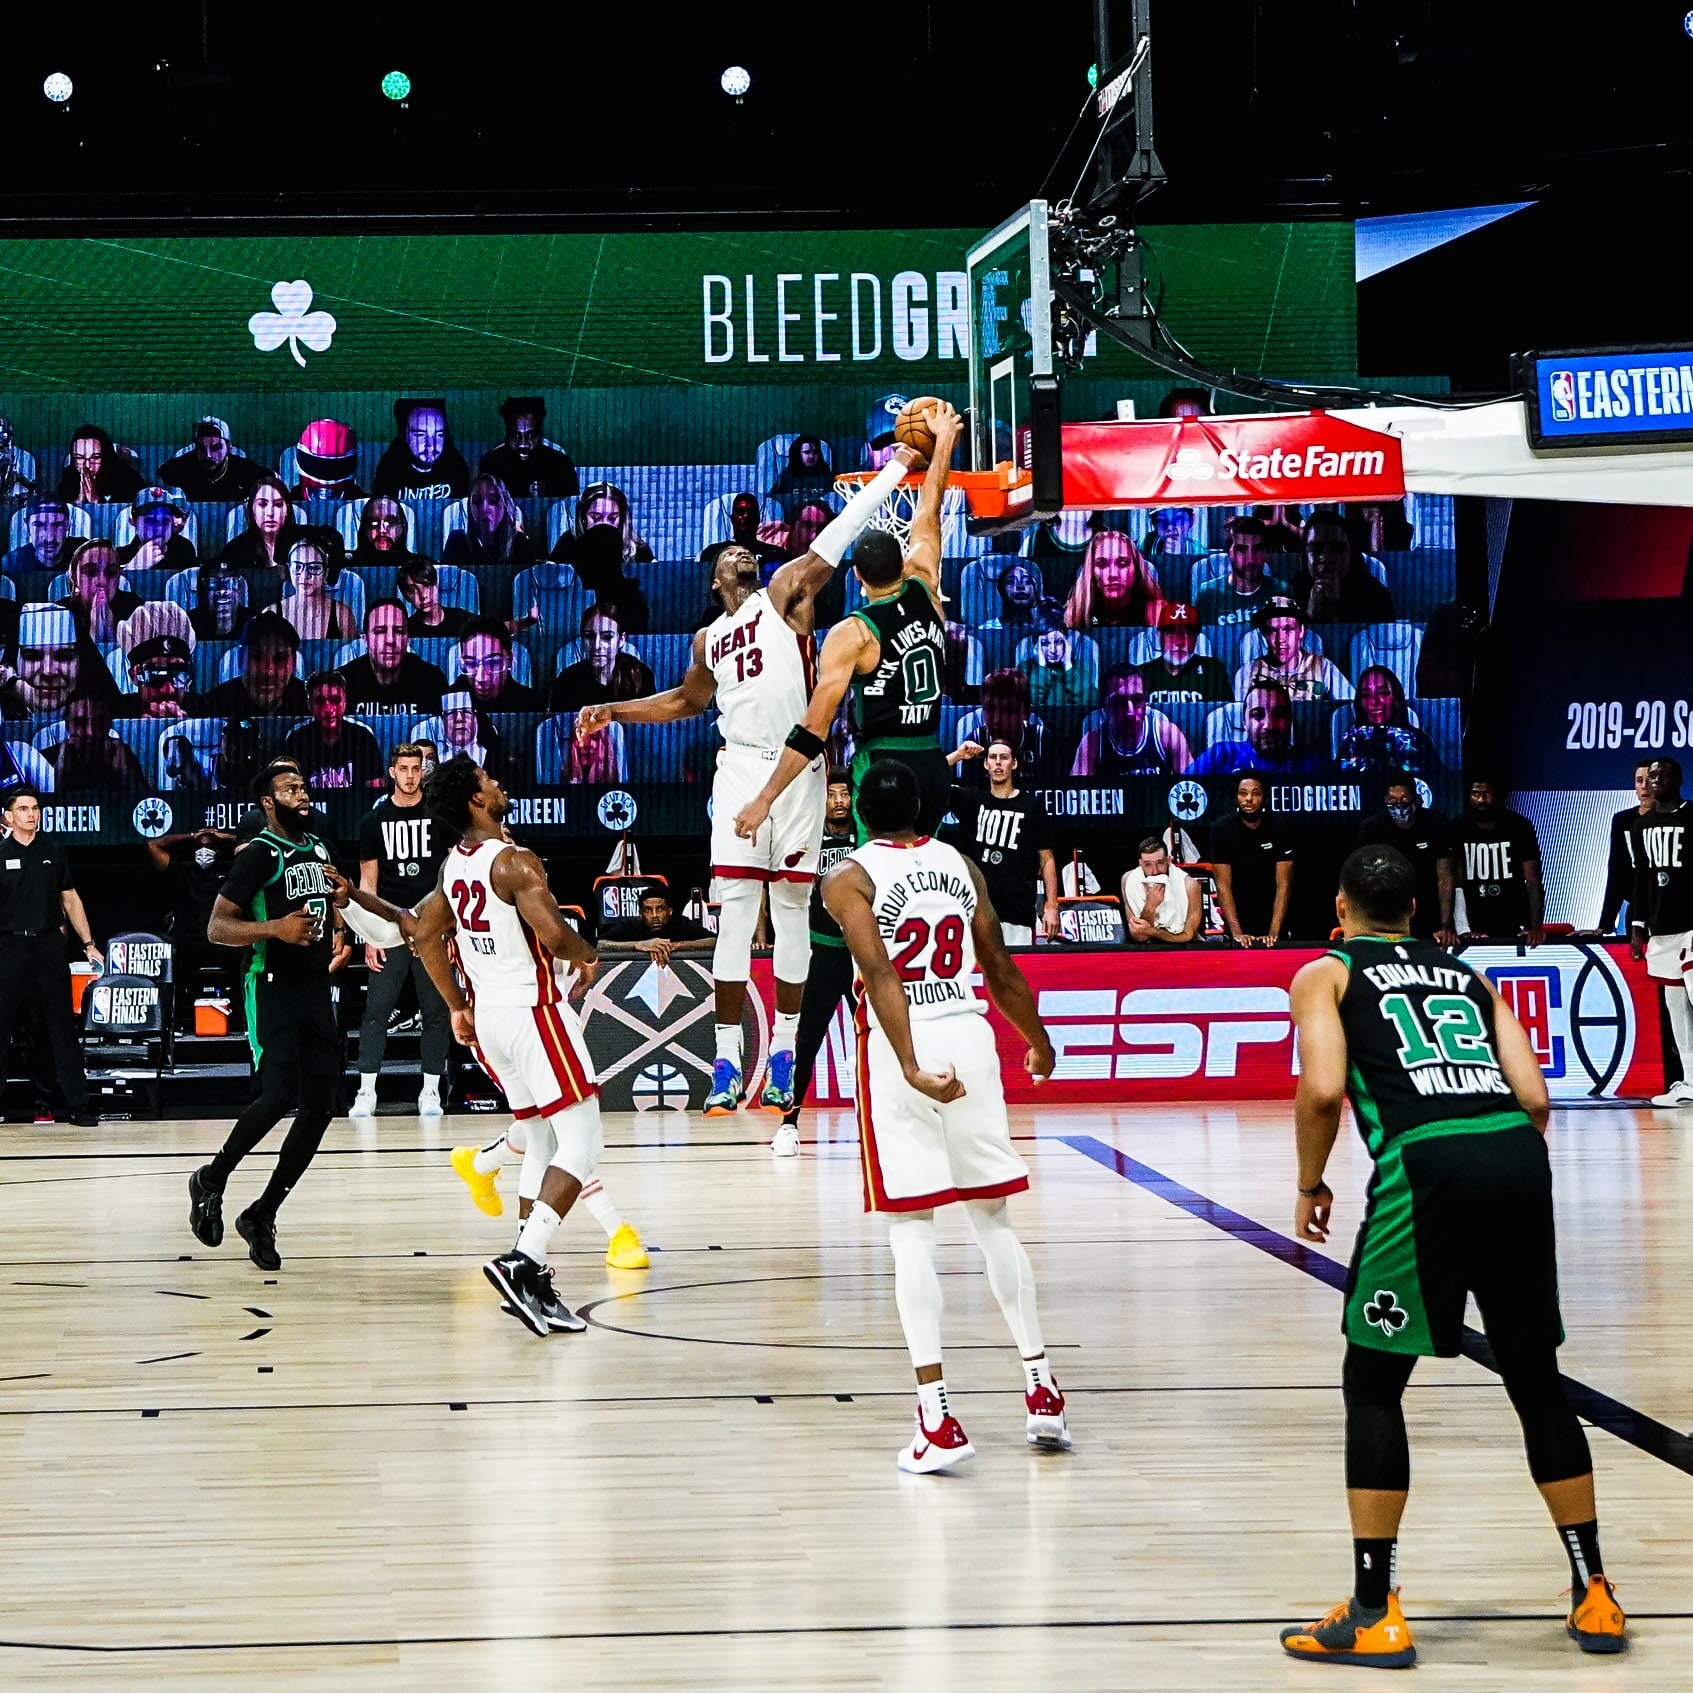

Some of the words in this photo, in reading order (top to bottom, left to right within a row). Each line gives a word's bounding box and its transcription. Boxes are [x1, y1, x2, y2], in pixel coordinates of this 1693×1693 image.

[711, 609, 763, 668] HEAT
[890, 620, 928, 656] LIVES
[734, 648, 763, 683] 13
[902, 645, 941, 704] 0
[1566, 700, 1667, 750] 2019-20
[1672, 700, 1693, 749] S
[381, 818, 433, 861] VOTE
[976, 803, 1025, 851] VOTE
[1464, 841, 1514, 881] VOTE
[1643, 826, 1685, 868] VOTE
[452, 879, 491, 933] 22
[876, 882, 909, 939] GROUP
[1078, 908, 1123, 926] EASTERN
[128, 943, 172, 961] EASTERN
[890, 914, 965, 982] 28
[1080, 924, 1114, 942] FINALS
[128, 959, 161, 977] FINALS
[1363, 963, 1472, 993] EQUALITY
[111, 1005, 148, 1024] FINALS
[112, 987, 159, 1006] EASTERN
[1378, 993, 1500, 1070] 12
[1408, 1066, 1512, 1096] WILLIAMS
[1383, 1625, 1400, 1642] T
